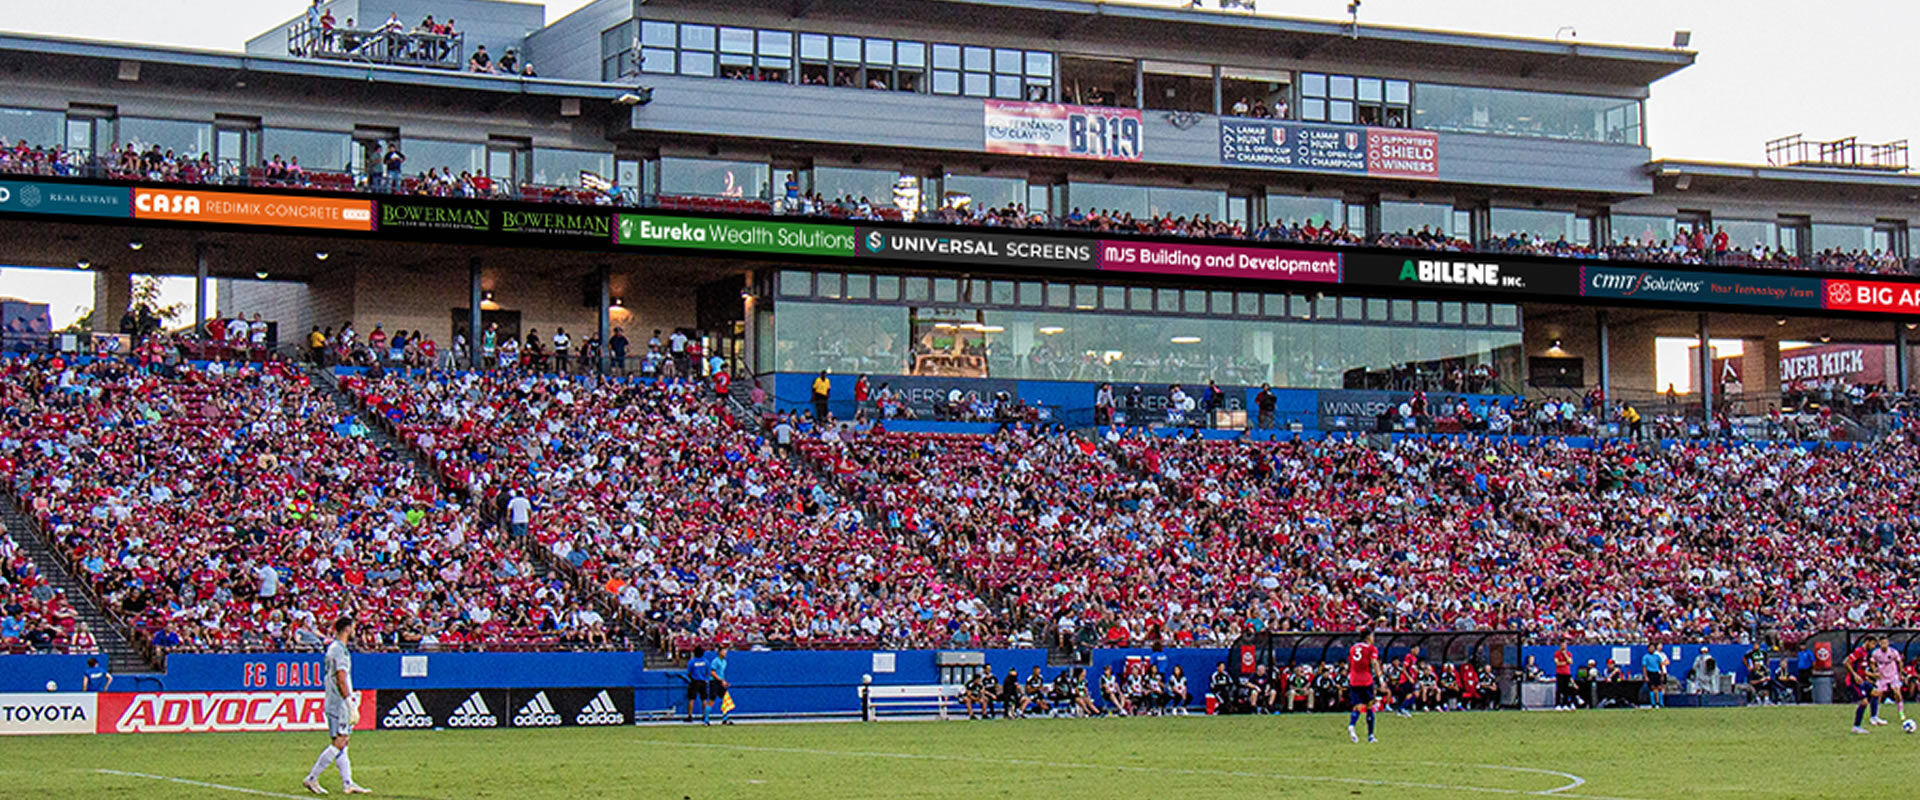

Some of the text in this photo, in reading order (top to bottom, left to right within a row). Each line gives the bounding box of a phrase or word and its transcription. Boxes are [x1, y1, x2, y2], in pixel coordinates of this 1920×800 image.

[1223, 125, 1235, 160] 1997
[1298, 129, 1309, 165] 2016
[1370, 134, 1381, 169] 2016
[1382, 145, 1434, 160] SHIELD
[1237, 153, 1292, 165] CHAMPIONS
[1311, 158, 1365, 169] CHAMPIONS
[1382, 158, 1435, 172] WINNERS
[50, 193, 119, 206] REAL ESTATE
[135, 193, 200, 215] CASA
[206, 200, 261, 216] REDIMIX
[264, 203, 339, 220] CONCRETE
[382, 204, 490, 226] BOWERMAN
[502, 210, 610, 234] BOWERMAN
[640, 220, 855, 250] Eureka Wealth Solutions
[891, 235, 1091, 262] UNIVERSAL SCREENS
[1105, 246, 1337, 276] MJS Building and Development
[1399, 259, 1499, 287] ABILENE
[1641, 274, 1701, 294] Solutions
[1734, 284, 1788, 299] Technology
[1790, 286, 1814, 298] Team
[1857, 286, 1893, 305] BIG
[1821, 349, 1865, 376] KICK
[1351, 647, 1363, 661] 3
[243, 662, 325, 687] FC DALL
[3, 705, 86, 722] TOYOTA
[118, 692, 328, 732] ADVOCAR
[383, 714, 434, 728] adidas
[447, 714, 498, 727] adidas
[513, 713, 563, 726] adidas
[576, 712, 625, 725] adidas
